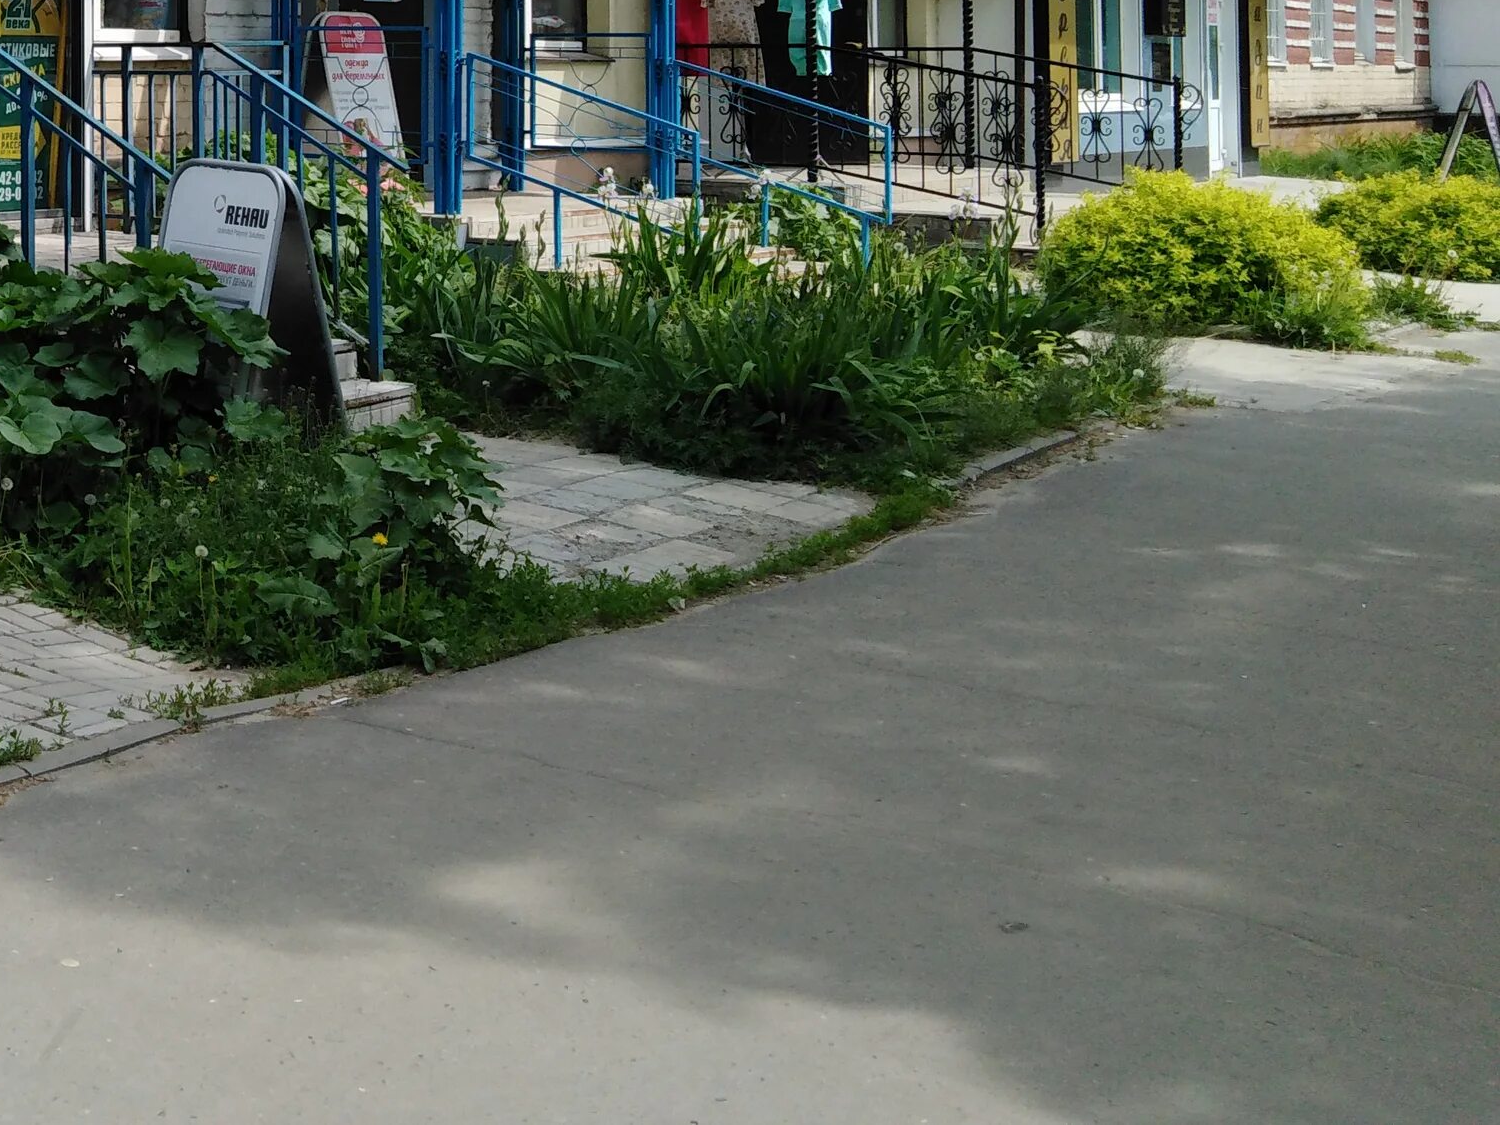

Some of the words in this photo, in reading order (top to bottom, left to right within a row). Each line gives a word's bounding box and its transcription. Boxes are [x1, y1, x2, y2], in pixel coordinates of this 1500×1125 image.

[5, 18, 31, 30] века
[225, 205, 270, 229] REHAU
[237, 264, 256, 278] ОКНА
